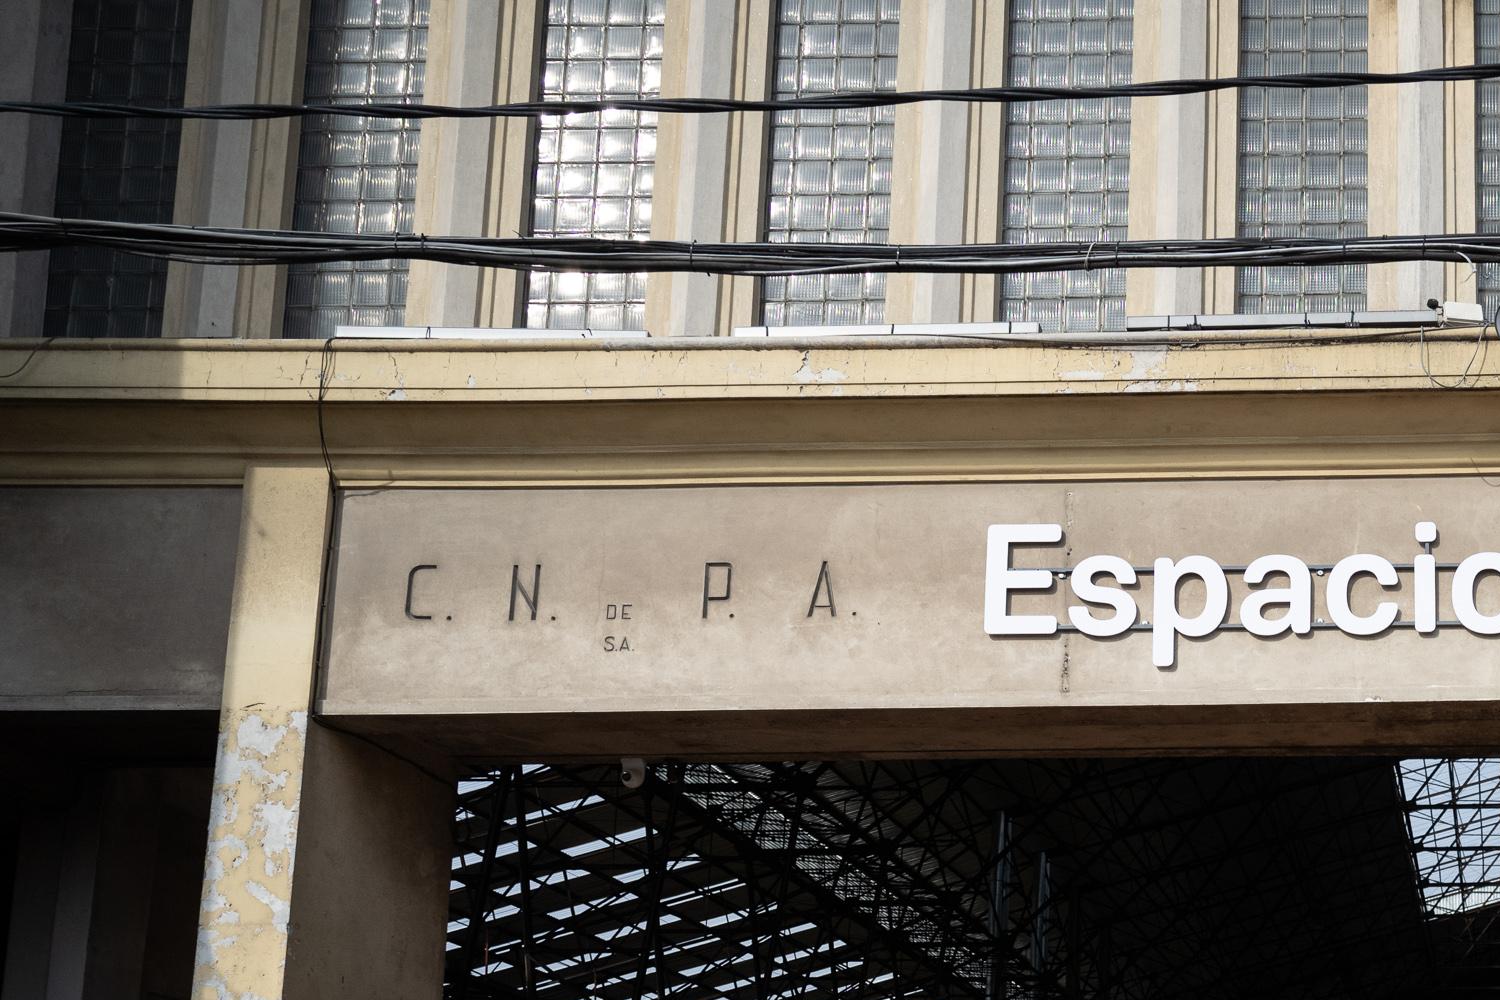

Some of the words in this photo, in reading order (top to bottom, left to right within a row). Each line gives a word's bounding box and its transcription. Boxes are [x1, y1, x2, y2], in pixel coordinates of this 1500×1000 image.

[404, 563, 453, 622] C.
[508, 563, 557, 622] N.
[606, 603, 634, 621] DE
[702, 561, 736, 620] P.
[806, 559, 858, 619] A.
[603, 636, 635, 653] S.A.
